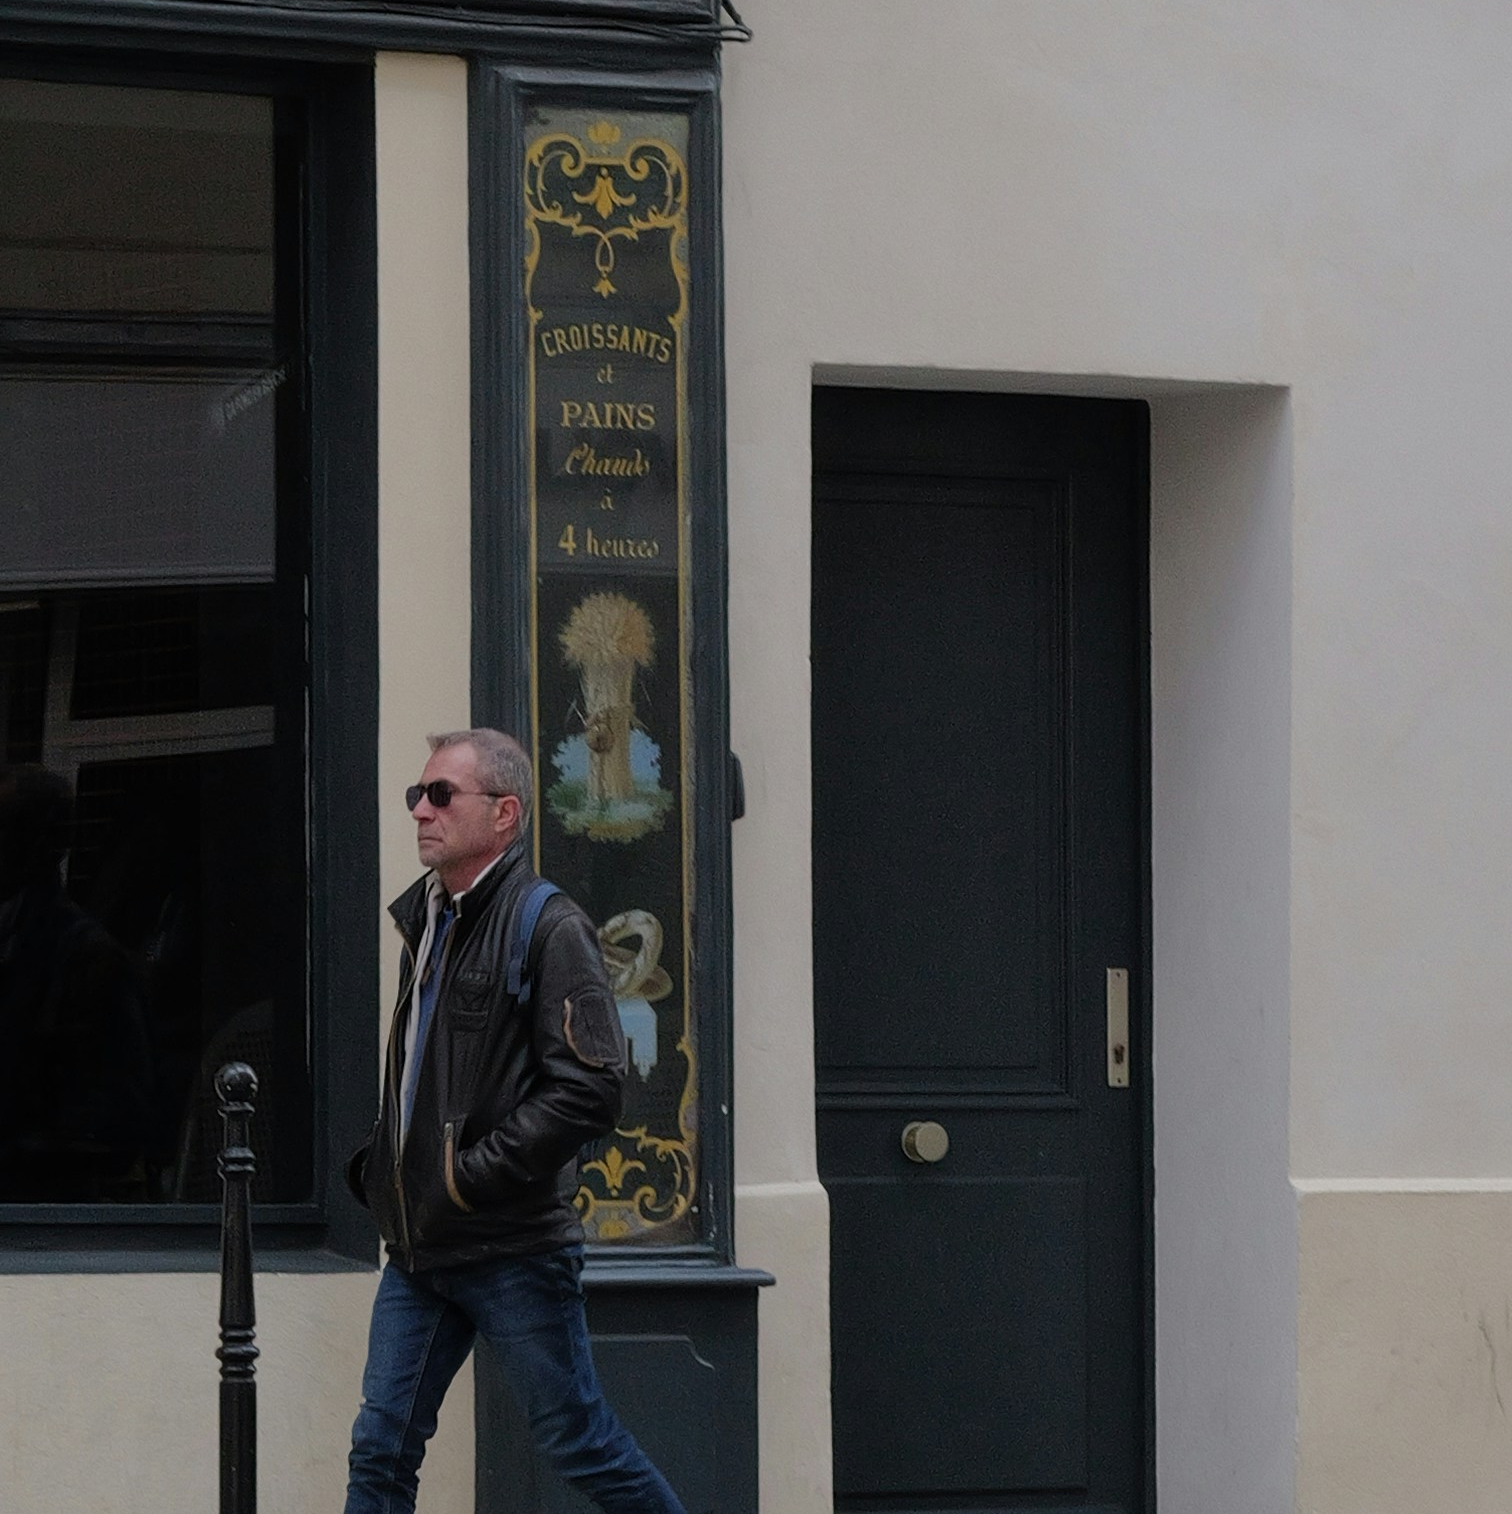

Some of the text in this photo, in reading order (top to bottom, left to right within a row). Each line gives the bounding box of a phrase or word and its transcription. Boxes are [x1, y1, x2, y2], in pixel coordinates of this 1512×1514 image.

[541, 323, 672, 363] CROISSANTS
[597, 364, 615, 384] et
[560, 400, 656, 430] PAINS
[601, 487, 615, 510] à
[558, 524, 660, 558] 4 heures
